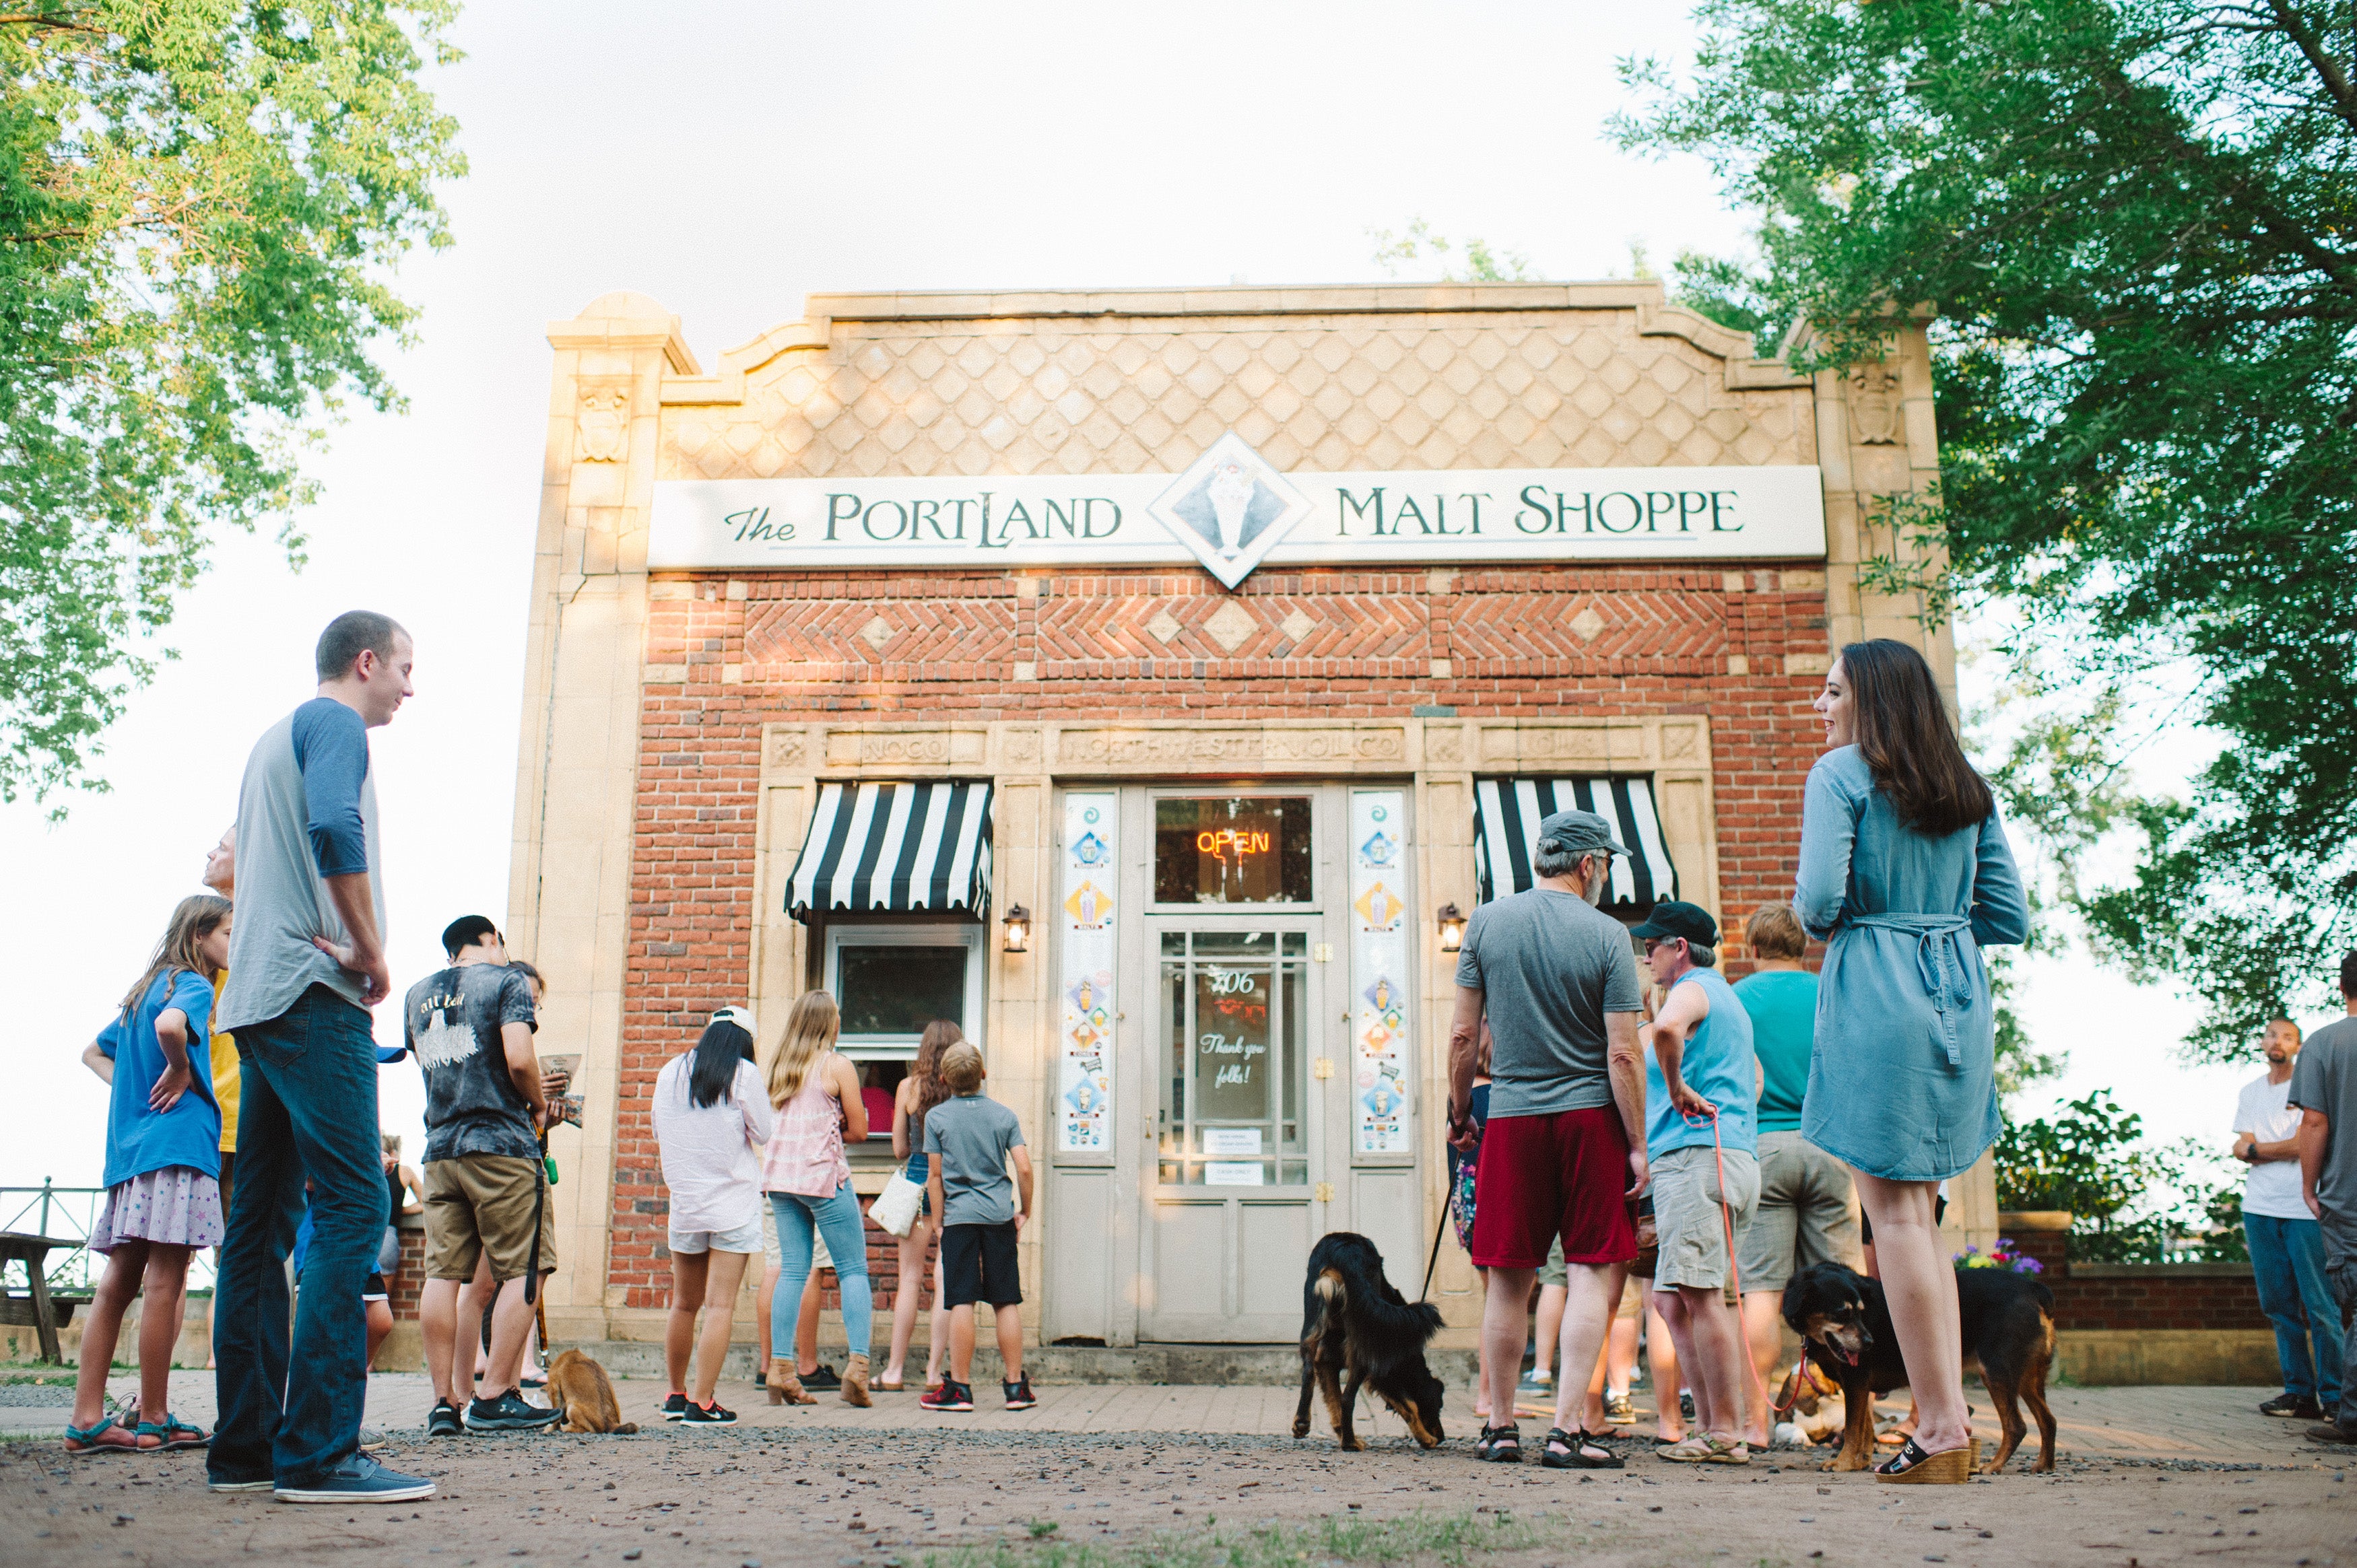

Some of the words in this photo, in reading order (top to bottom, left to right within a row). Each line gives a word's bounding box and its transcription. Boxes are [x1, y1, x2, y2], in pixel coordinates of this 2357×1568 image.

[724, 506, 795, 541] The
[822, 493, 1122, 549] PORTLAND
[1335, 487, 1494, 535] MALT
[1515, 485, 1745, 534] SHOPPE
[865, 741, 943, 759] NOCO
[1197, 831, 1269, 854] OPEN
[1199, 1033, 1244, 1054] Thank
[1243, 1044, 1266, 1061] you
[1215, 1064, 1251, 1089] folks!
